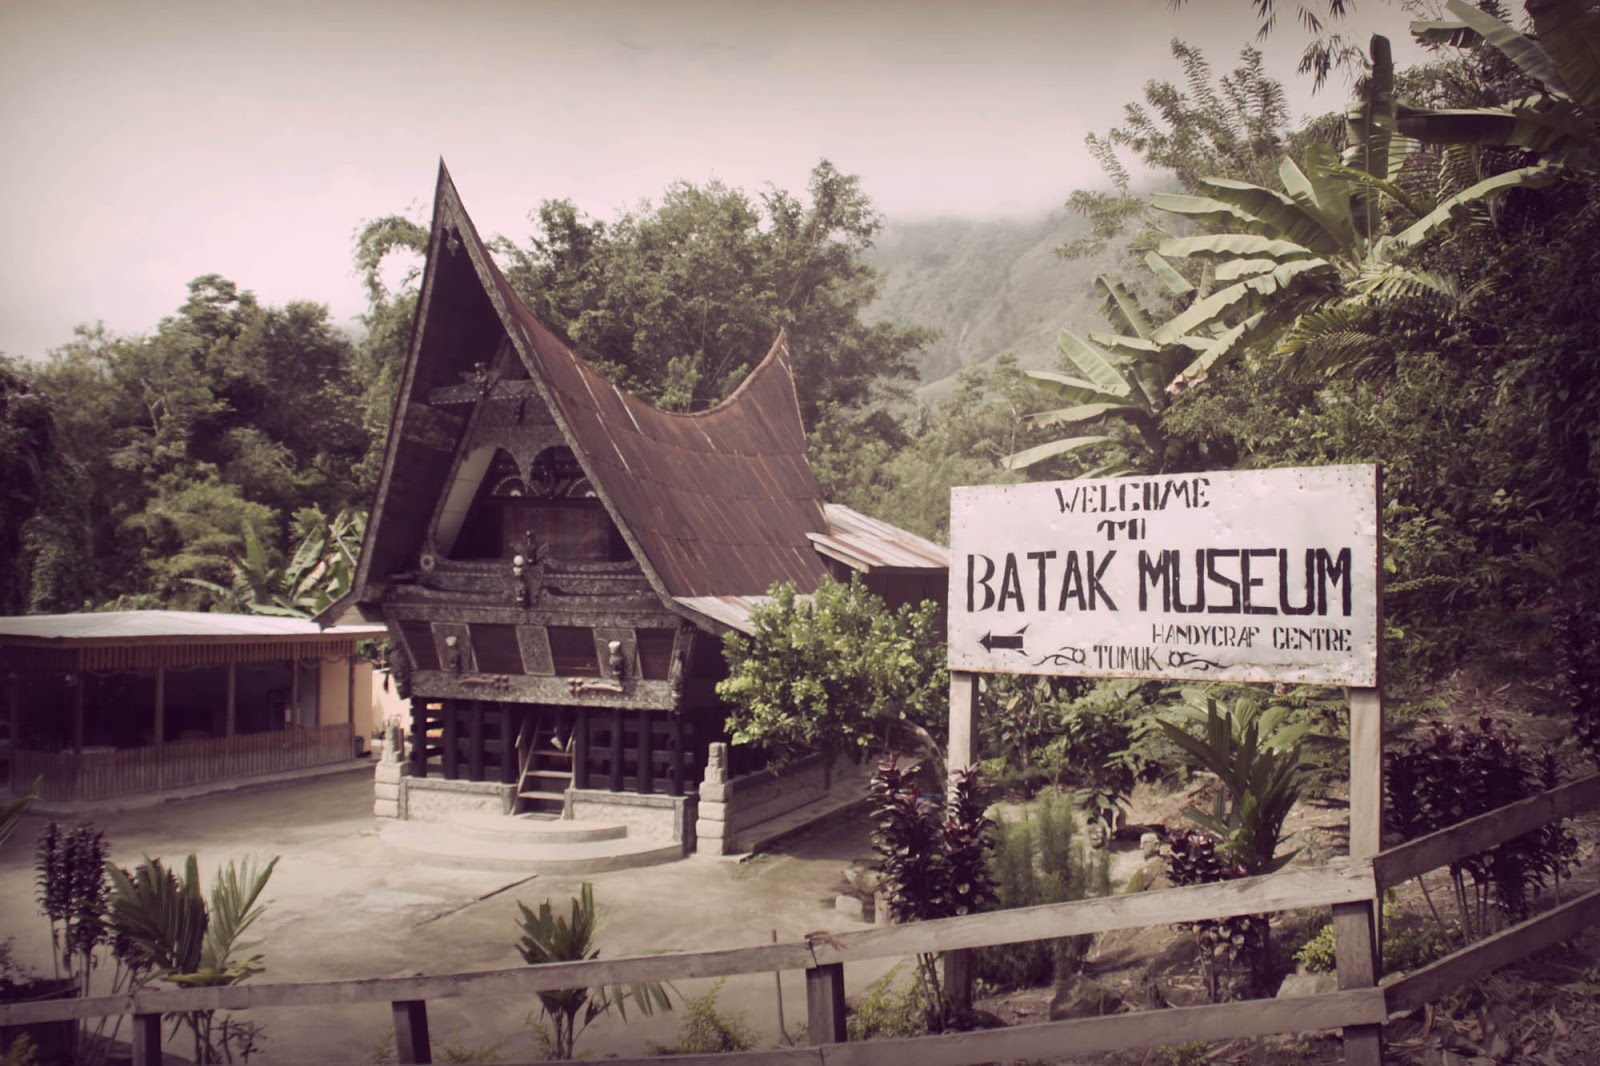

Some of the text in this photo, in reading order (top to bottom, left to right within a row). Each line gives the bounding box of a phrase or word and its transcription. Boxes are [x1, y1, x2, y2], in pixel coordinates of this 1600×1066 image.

[1055, 478, 1211, 513] WELCOME
[1097, 518, 1146, 541] TO
[967, 547, 1352, 616] BATAK MUSEUM
[1272, 626, 1352, 652] CENTRE
